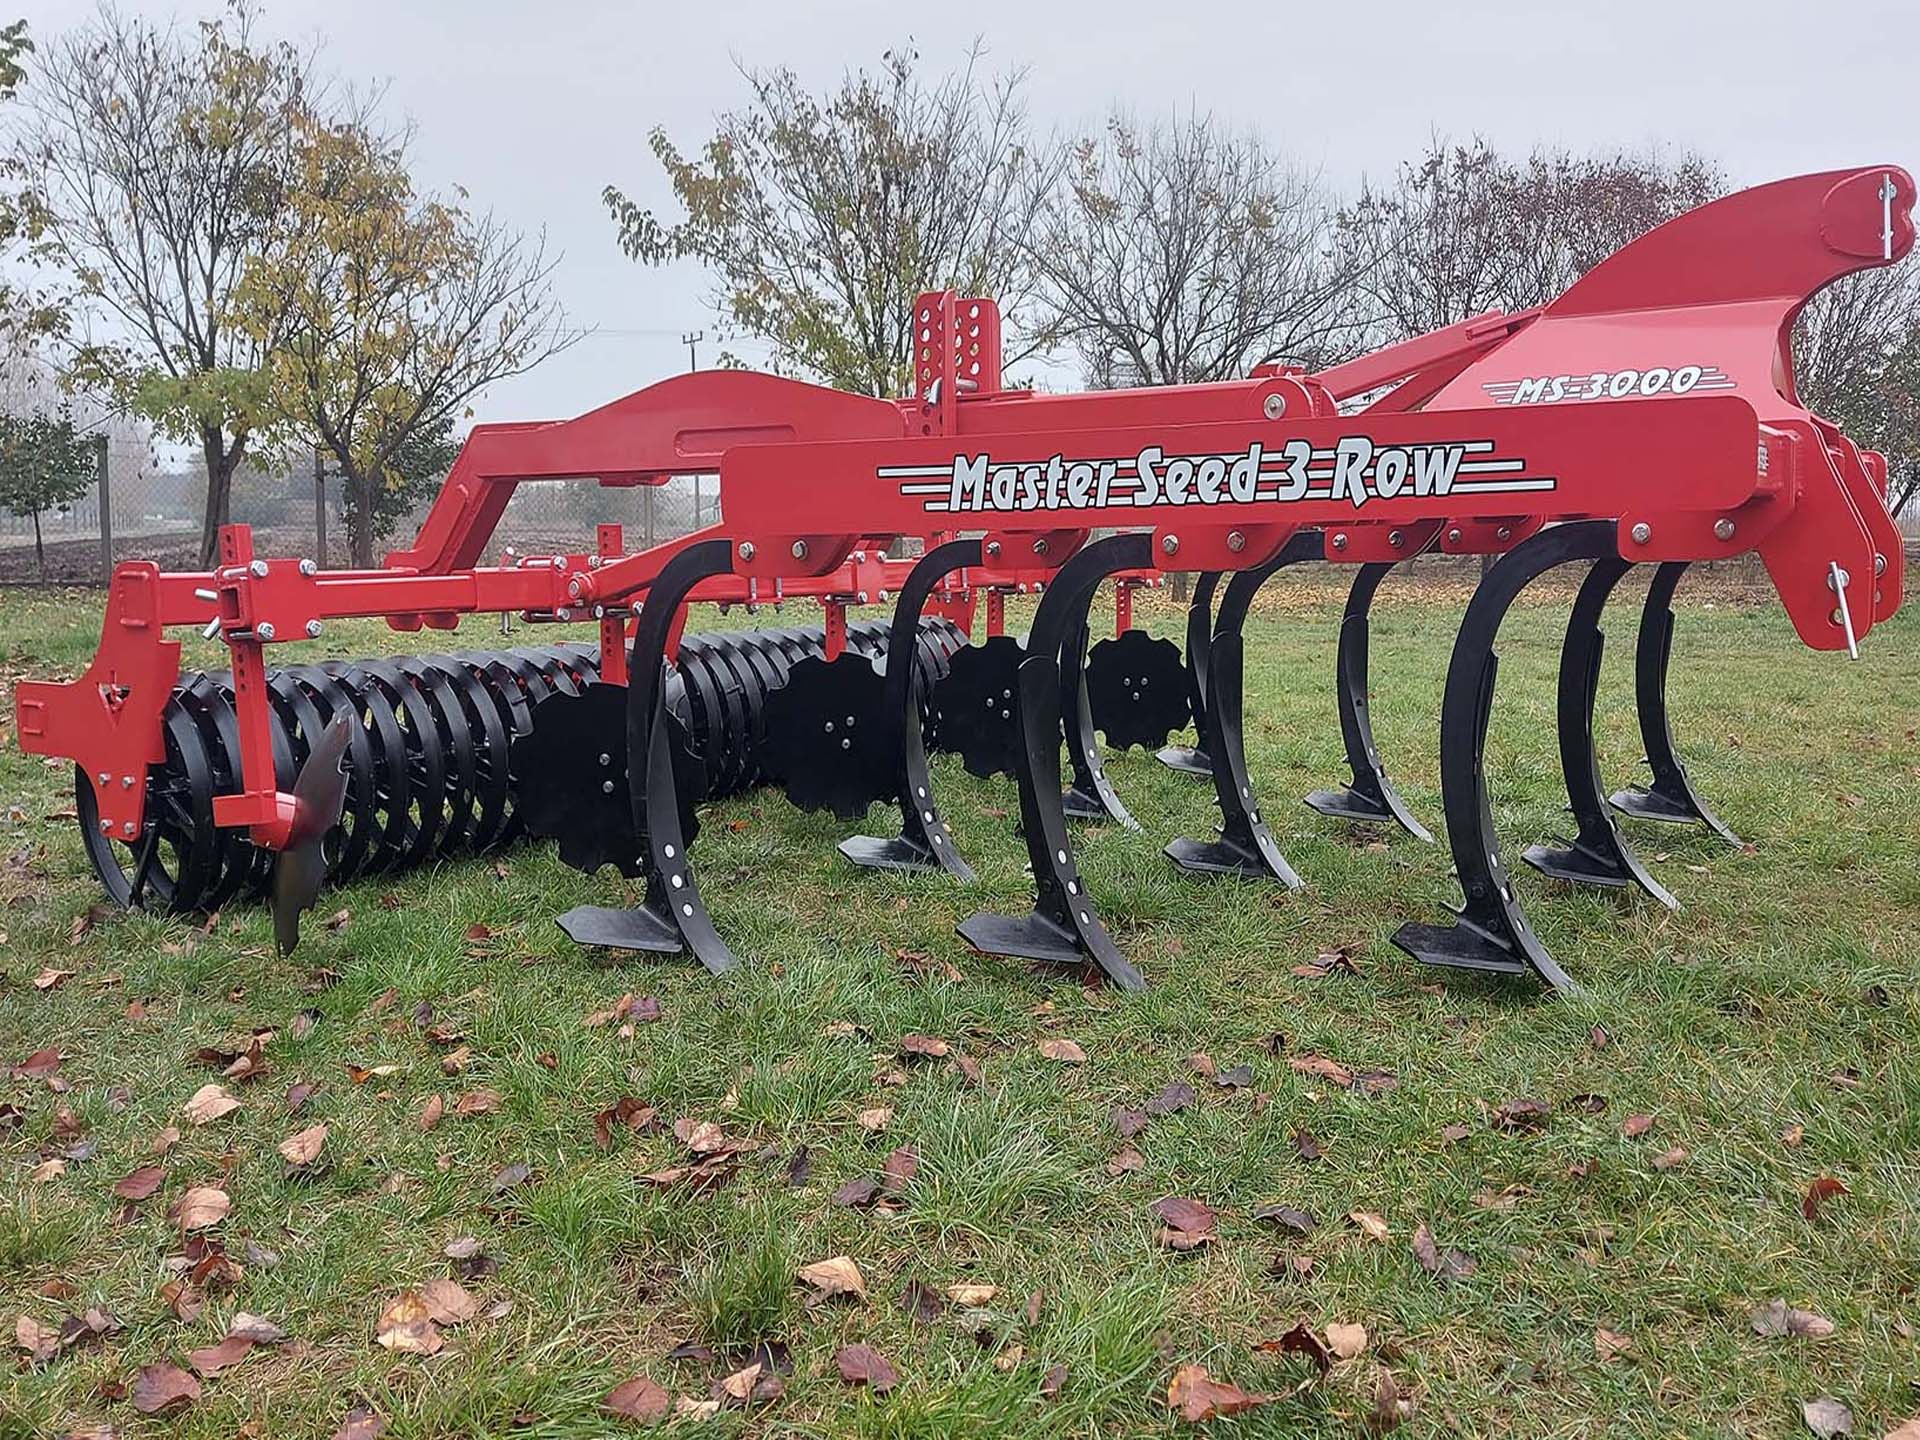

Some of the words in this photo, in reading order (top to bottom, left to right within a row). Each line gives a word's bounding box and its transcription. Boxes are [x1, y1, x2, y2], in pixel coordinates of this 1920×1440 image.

[1511, 365, 1702, 405] MS-3000
[949, 453, 1117, 511] Master
[1132, 440, 1263, 507] Seed
[1278, 439, 1312, 501] 3
[1330, 436, 1466, 509] Row
